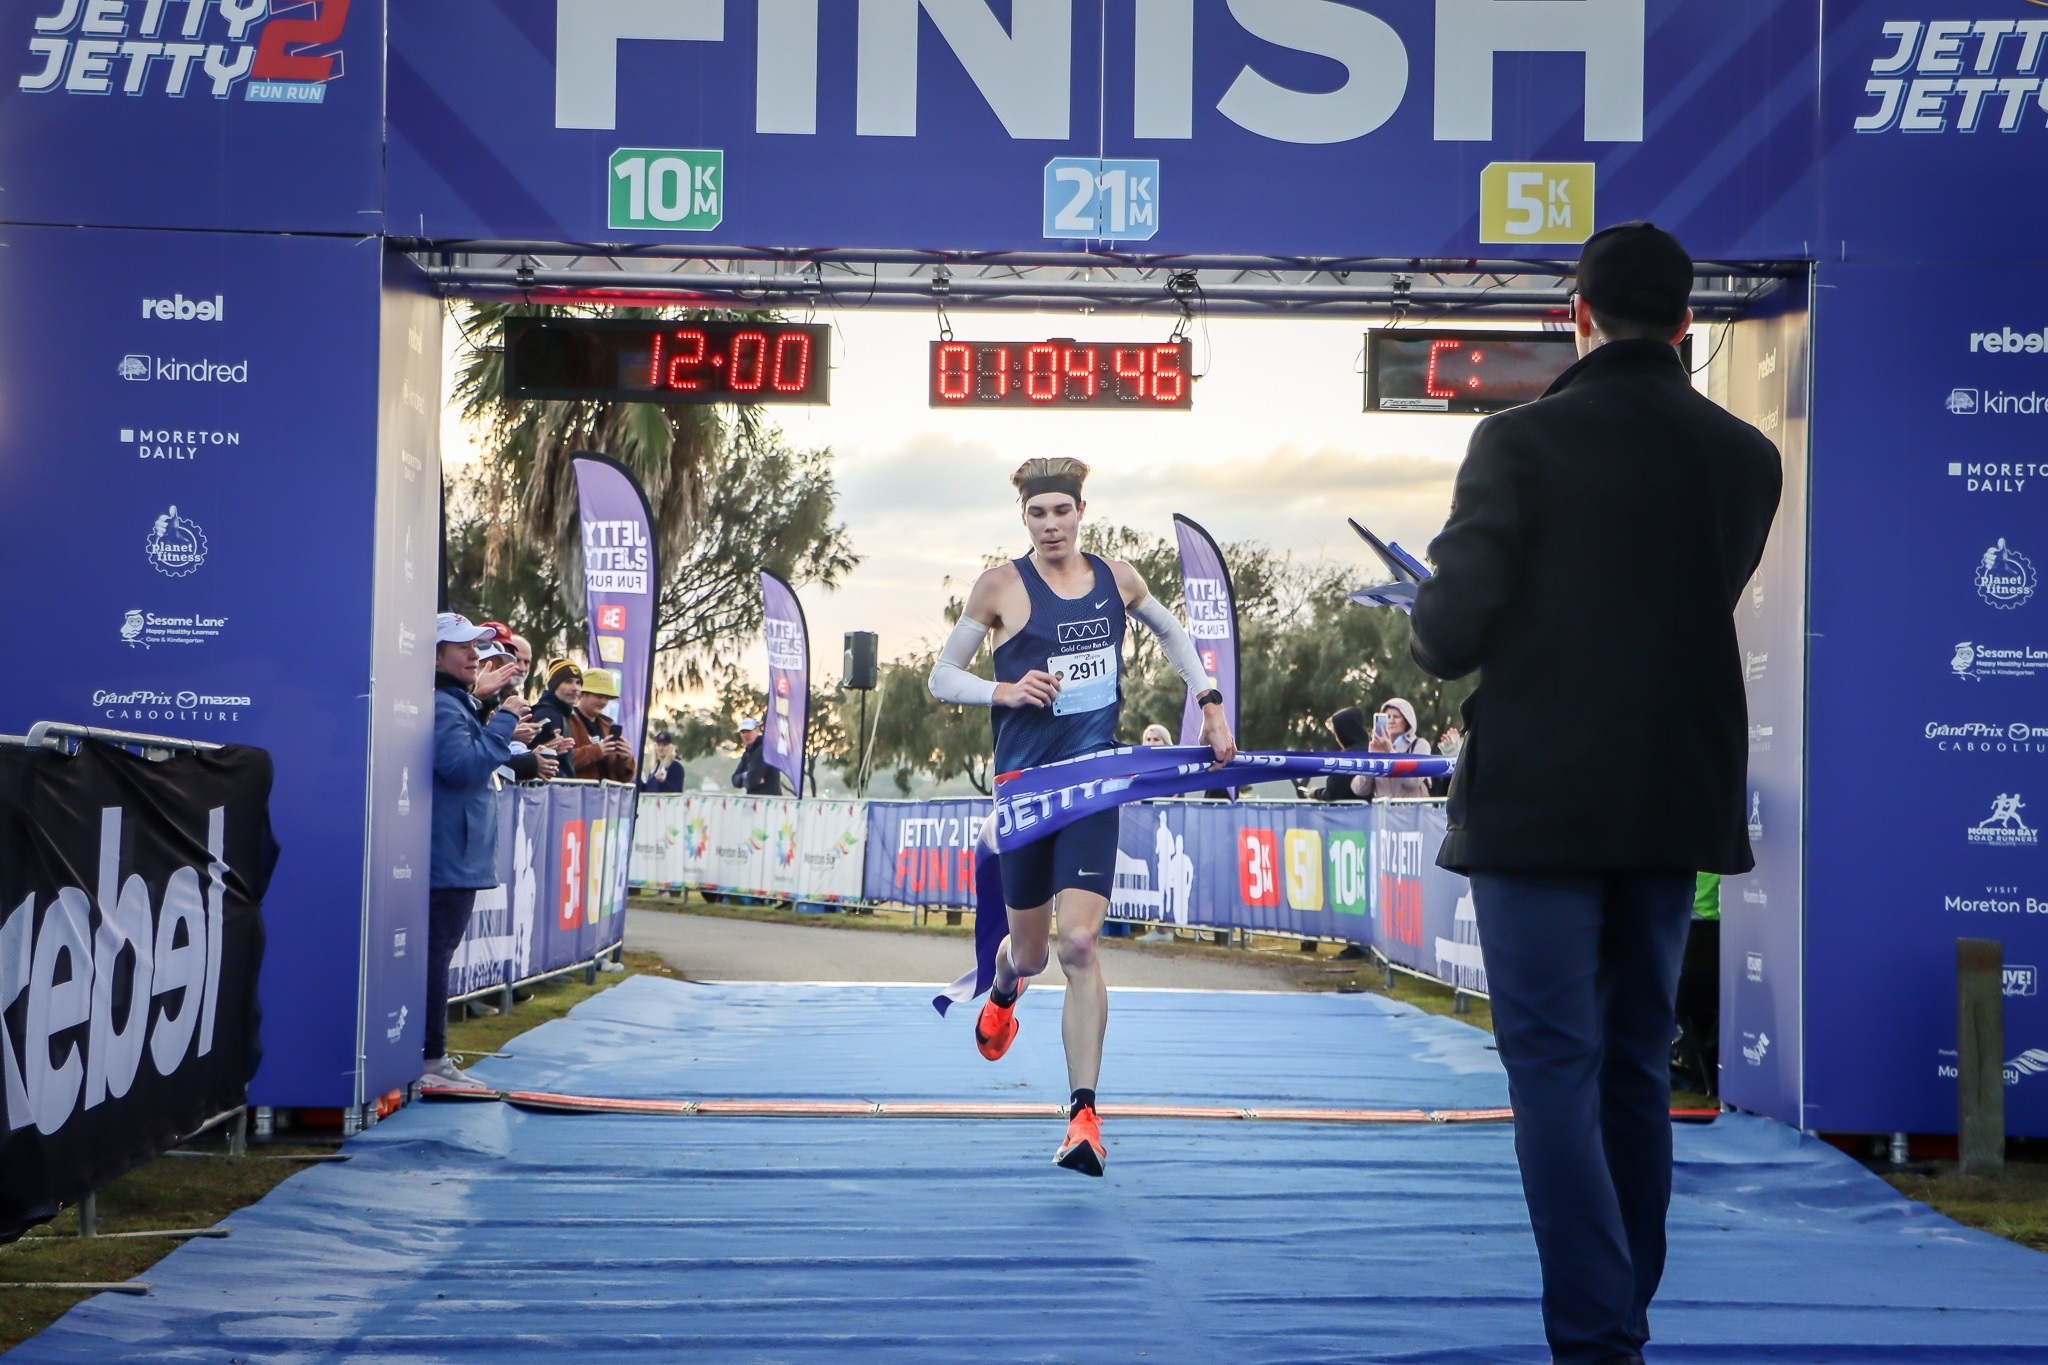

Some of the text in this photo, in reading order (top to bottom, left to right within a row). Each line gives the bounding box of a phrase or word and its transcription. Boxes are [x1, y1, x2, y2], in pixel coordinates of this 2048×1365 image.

[19, 38, 255, 96] JETTY
[555, 0, 1645, 144] FINISH
[250, 86, 322, 100] FUN RUN
[1853, 78, 2048, 131] JETT
[142, 294, 223, 321] rebel
[156, 357, 247, 383] kindred
[140, 430, 239, 445] MORETON
[139, 446, 197, 459] DAILY
[1967, 479, 2025, 492] DAILY
[152, 542, 193, 554] planet
[157, 552, 201, 562] fitness
[1980, 575, 2022, 587] planet
[1986, 584, 2030, 594] fitness
[146, 612, 193, 626] Sesame
[166, 628, 192, 636] Healthy
[1061, 645, 1075, 653] Gold
[1976, 645, 2048, 659] Sesame Lan
[1069, 658, 1106, 681] 2911
[1997, 661, 2022, 669] Healthy
[200, 696, 251, 706] mazda
[106, 709, 239, 721] CABOOLTURE
[899, 817, 946, 855] JETTY
[948, 817, 959, 847] 2
[1968, 827, 2038, 837] MORETON BAY
[1996, 835, 2038, 843] RUNNERS
[896, 848, 948, 893] FUN
[1944, 896, 2020, 913] Moreton
[2002, 970, 2032, 985] IVE!
